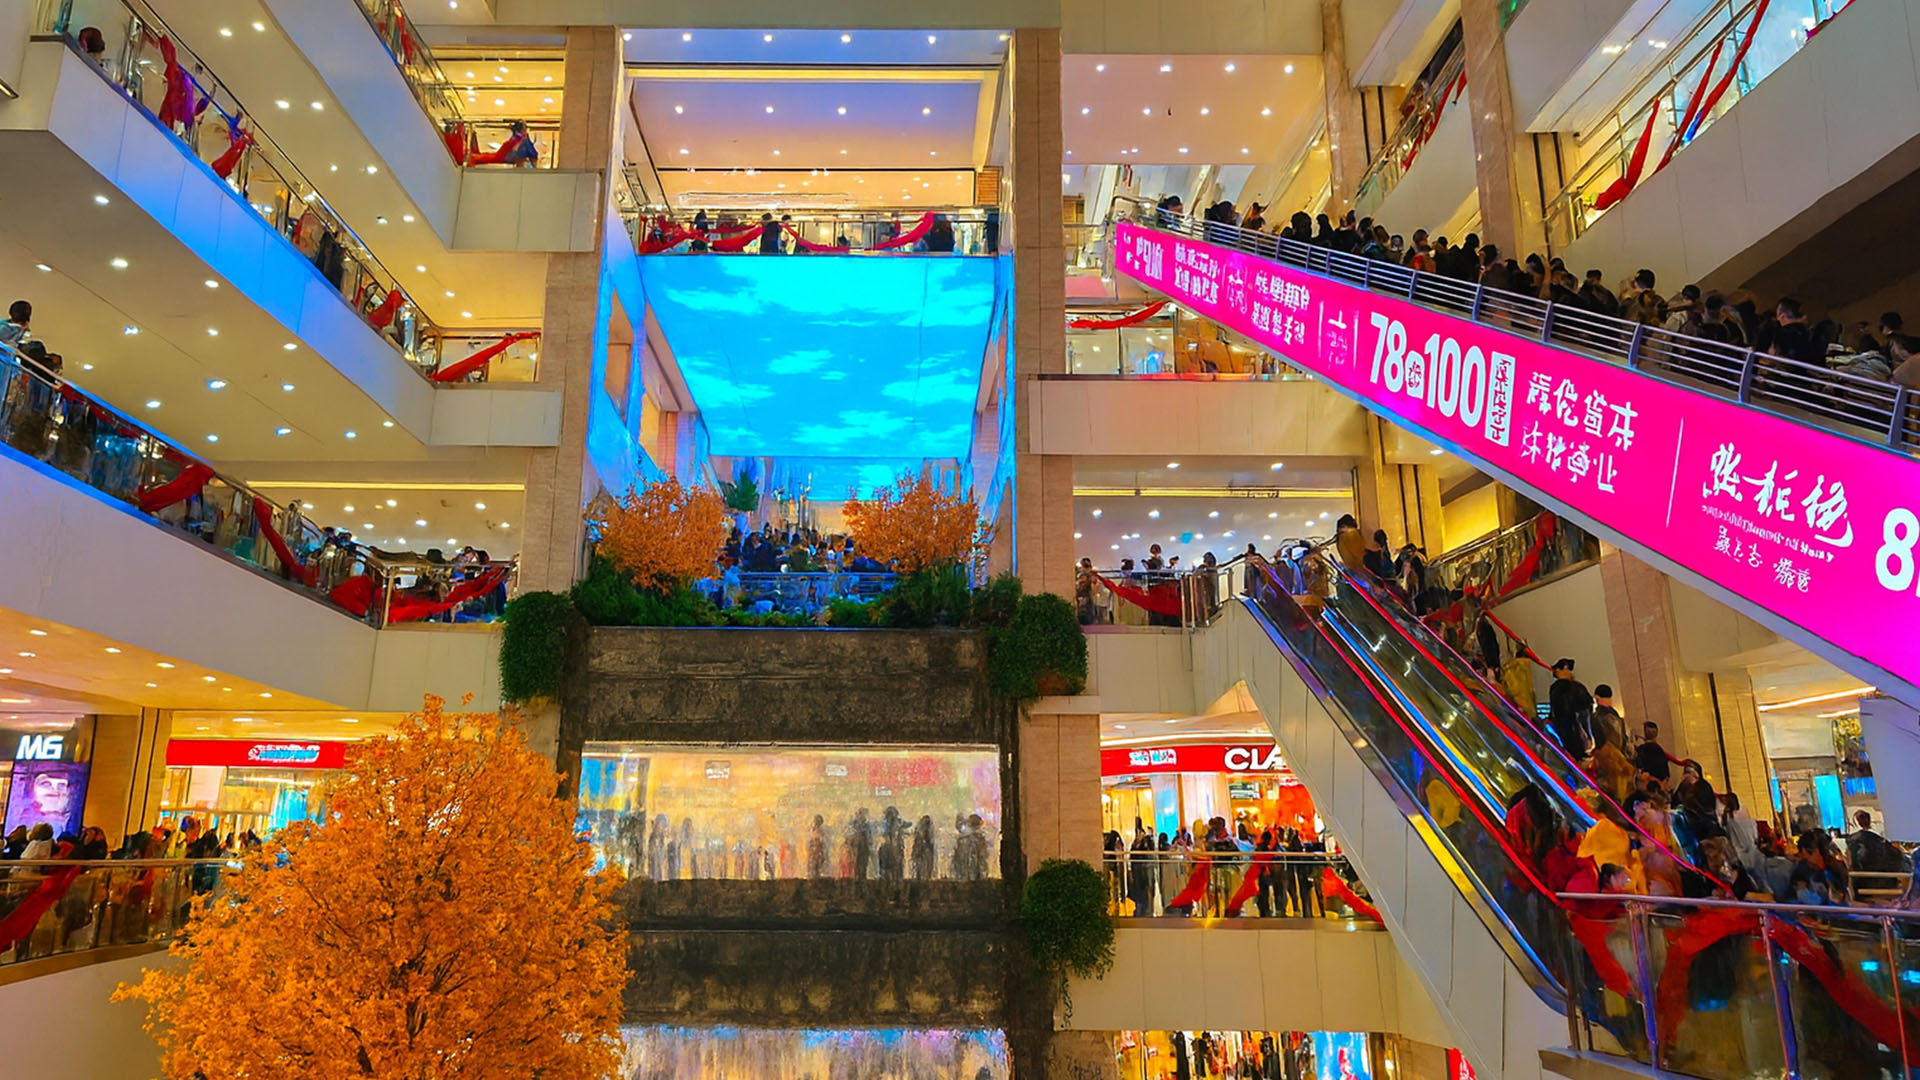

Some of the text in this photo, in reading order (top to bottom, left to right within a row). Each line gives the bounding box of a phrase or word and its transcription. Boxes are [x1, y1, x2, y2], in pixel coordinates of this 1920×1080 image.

[1370, 311, 1407, 393] 78
[1424, 333, 1486, 428] 100
[1875, 507, 1920, 598] 8
